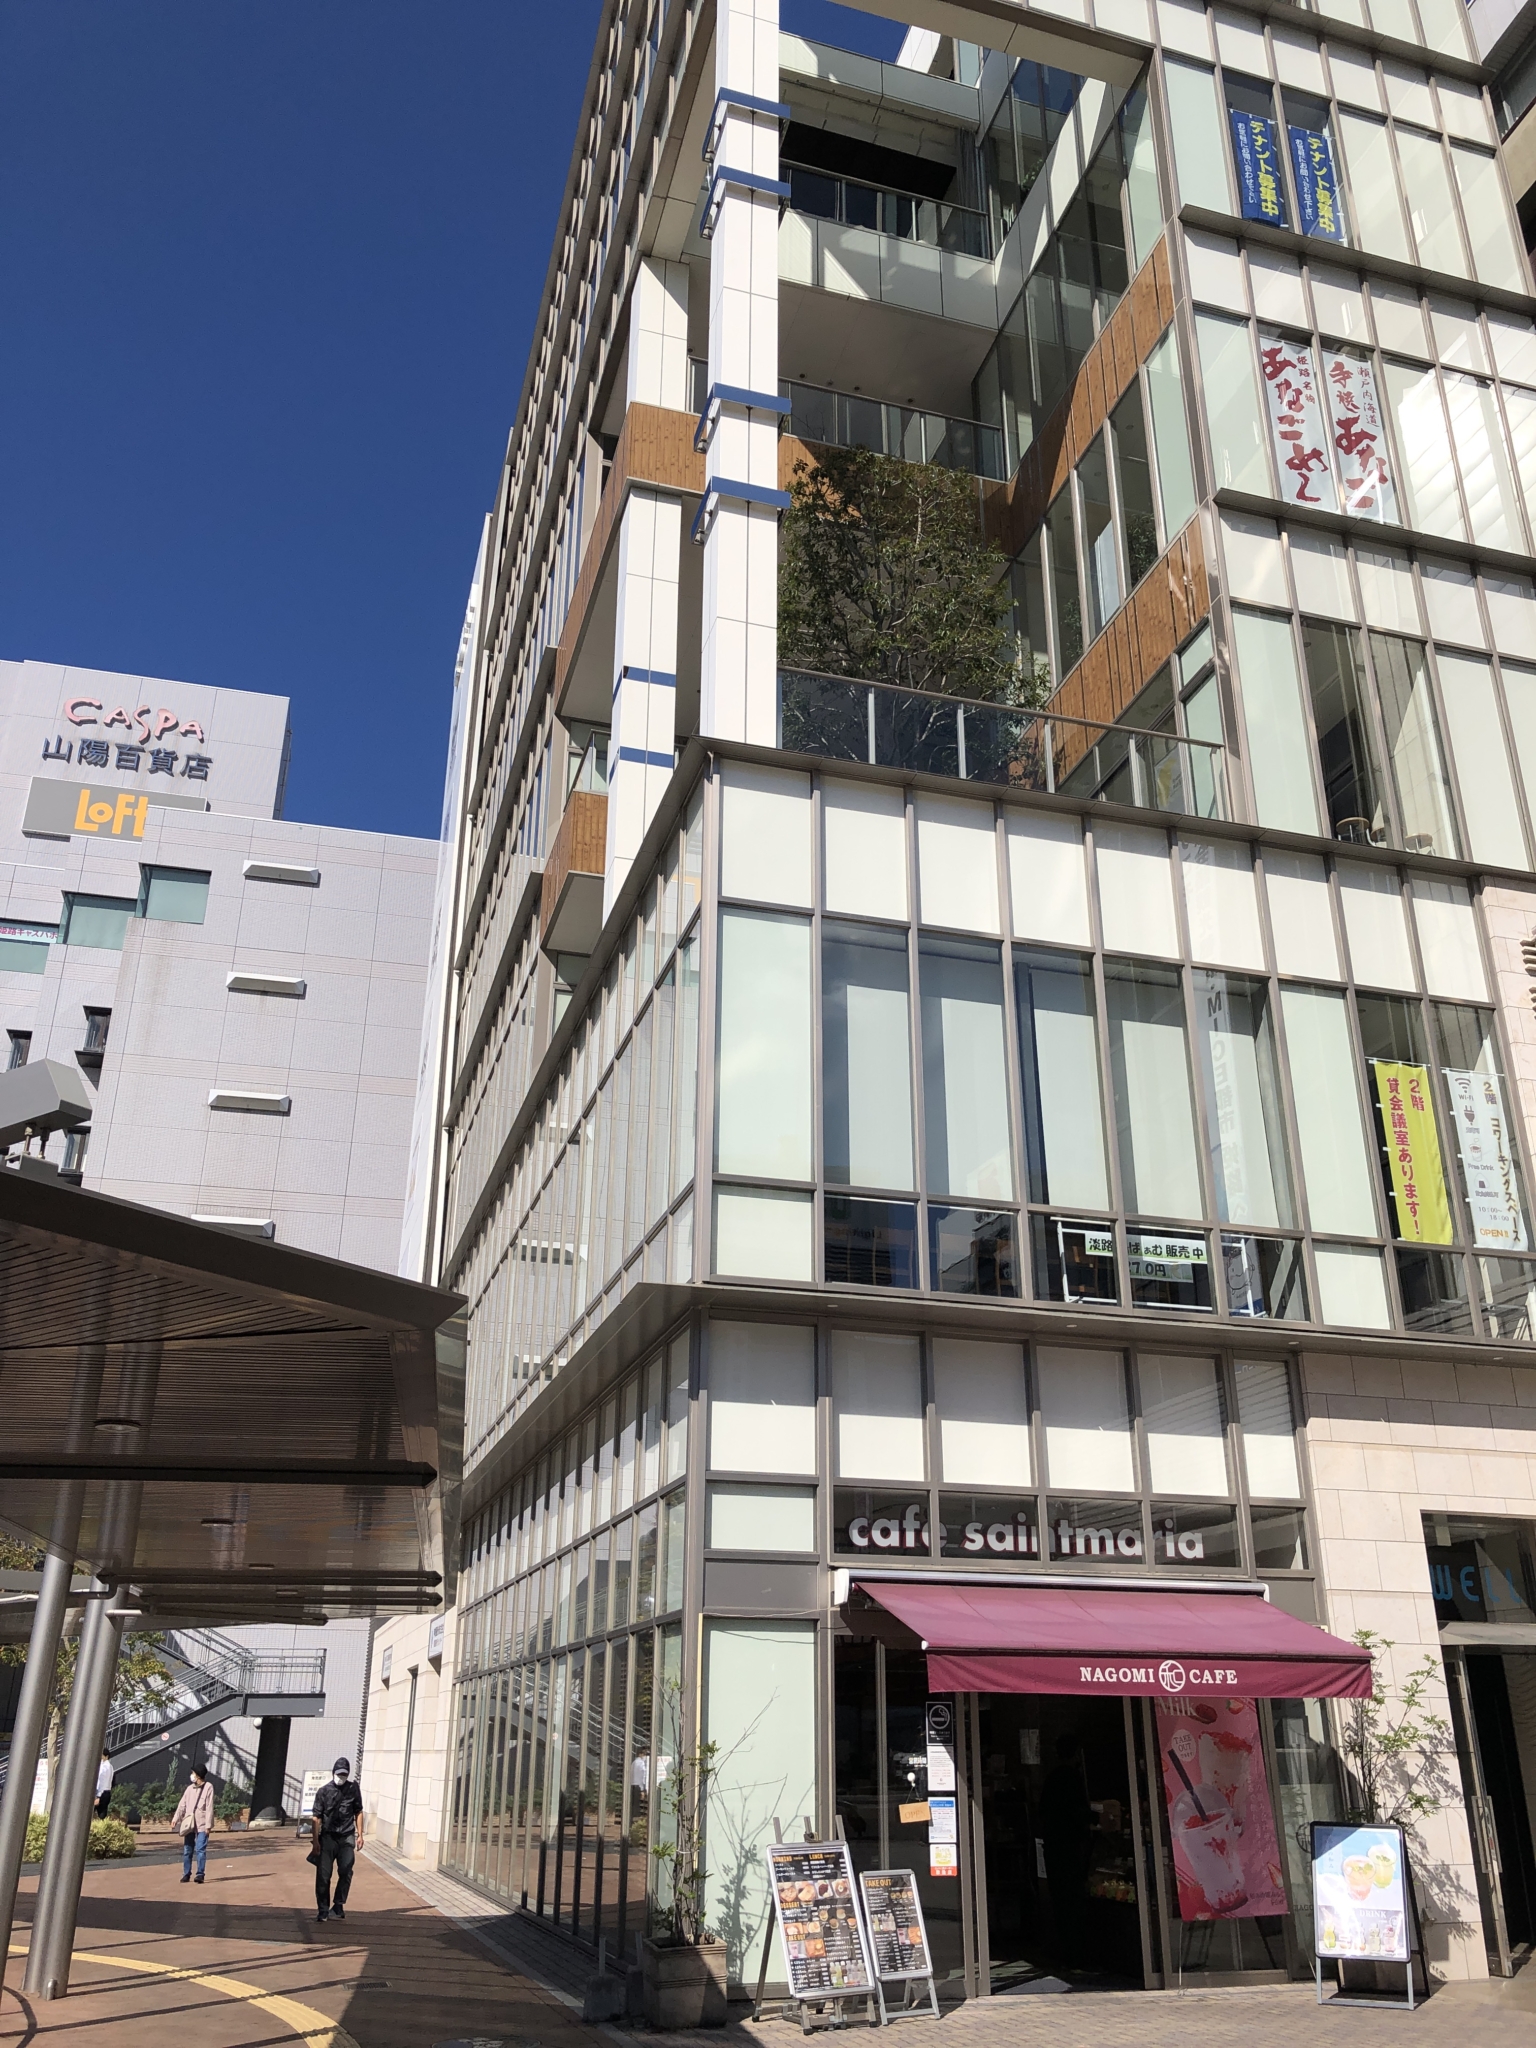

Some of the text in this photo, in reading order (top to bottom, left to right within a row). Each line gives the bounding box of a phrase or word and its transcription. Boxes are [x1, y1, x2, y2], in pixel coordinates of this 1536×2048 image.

[1250, 120, 1279, 217] テナント募集中
[1307, 136, 1336, 233] テナント募集中
[1297, 355, 1315, 404] 姫路名物
[64, 696, 205, 744] CASPA
[41, 735, 213, 781] 山陽百貨店
[1408, 1078, 1425, 1112] 2階
[1386, 1077, 1420, 1235] 貸会議室あります!
[1490, 1116, 1521, 1242] コワーキングスペース
[1080, 1667, 1155, 1683] NAGOMI
[1189, 1669, 1238, 1684] CAFE
[1173, 1734, 1192, 1745] TAKE
[1178, 1742, 1192, 1752] OUT
[865, 1878, 891, 1887] TAKE OUT
[1359, 1910, 1387, 1919] DRINK
